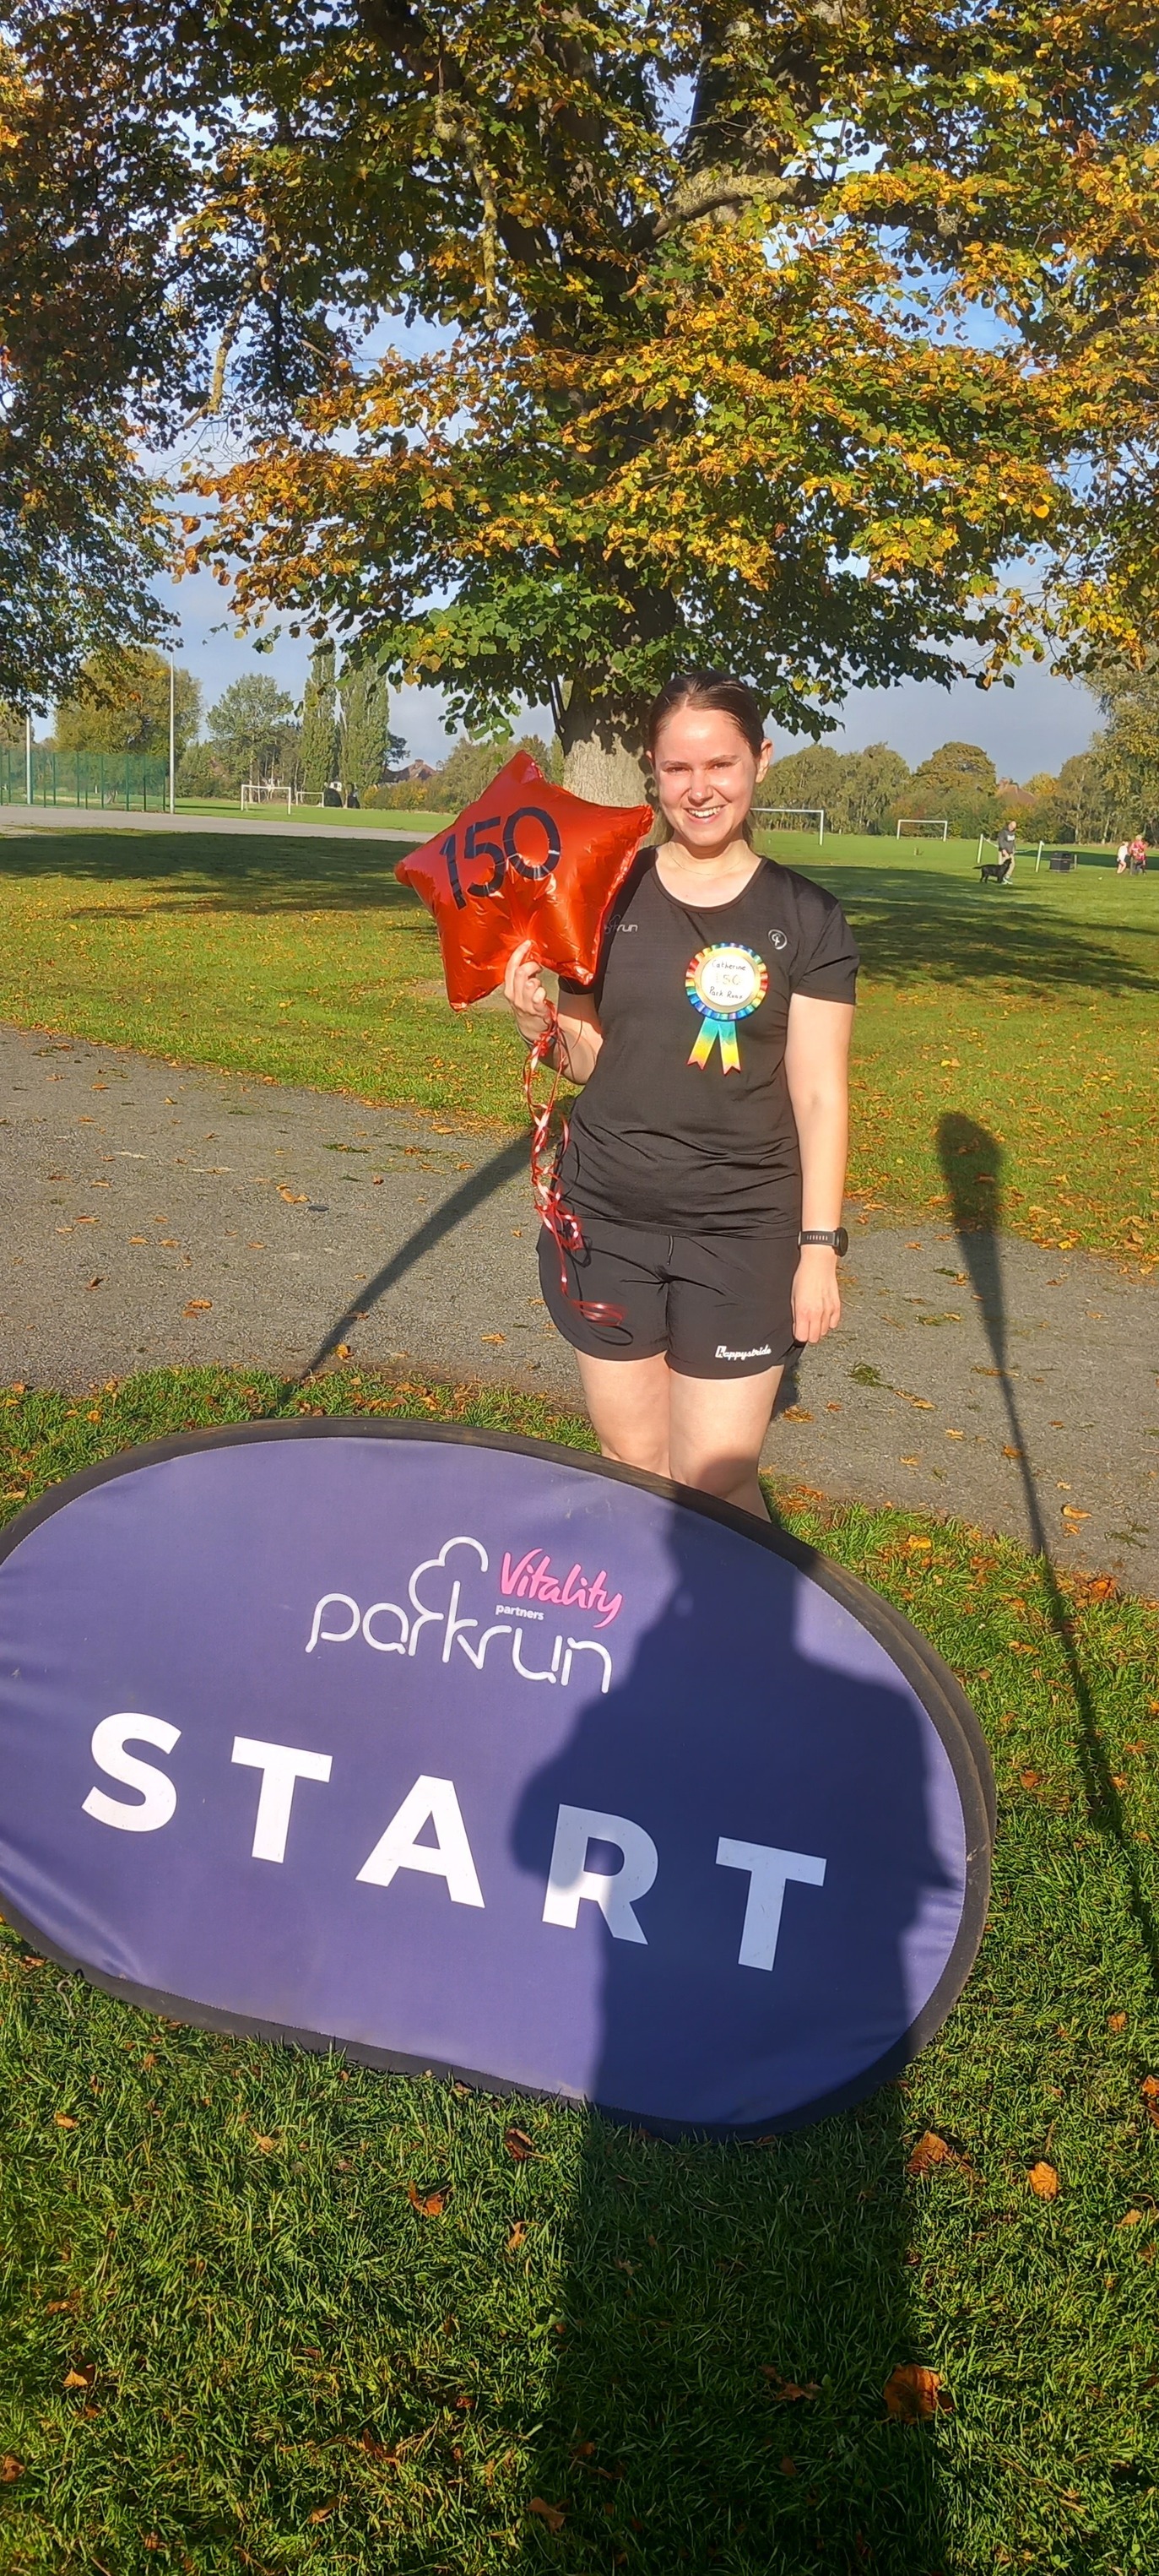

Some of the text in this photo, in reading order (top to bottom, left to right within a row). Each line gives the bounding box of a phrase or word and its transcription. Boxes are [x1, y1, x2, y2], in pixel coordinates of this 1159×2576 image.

[440, 806, 561, 910] 150
[709, 985, 723, 997] Park
[712, 959, 746, 971] Catherine
[305, 1535, 613, 1694] parkrun
[495, 1604, 544, 1620] partners
[501, 1548, 623, 1629] Vitality
[81, 1711, 827, 1971] START
